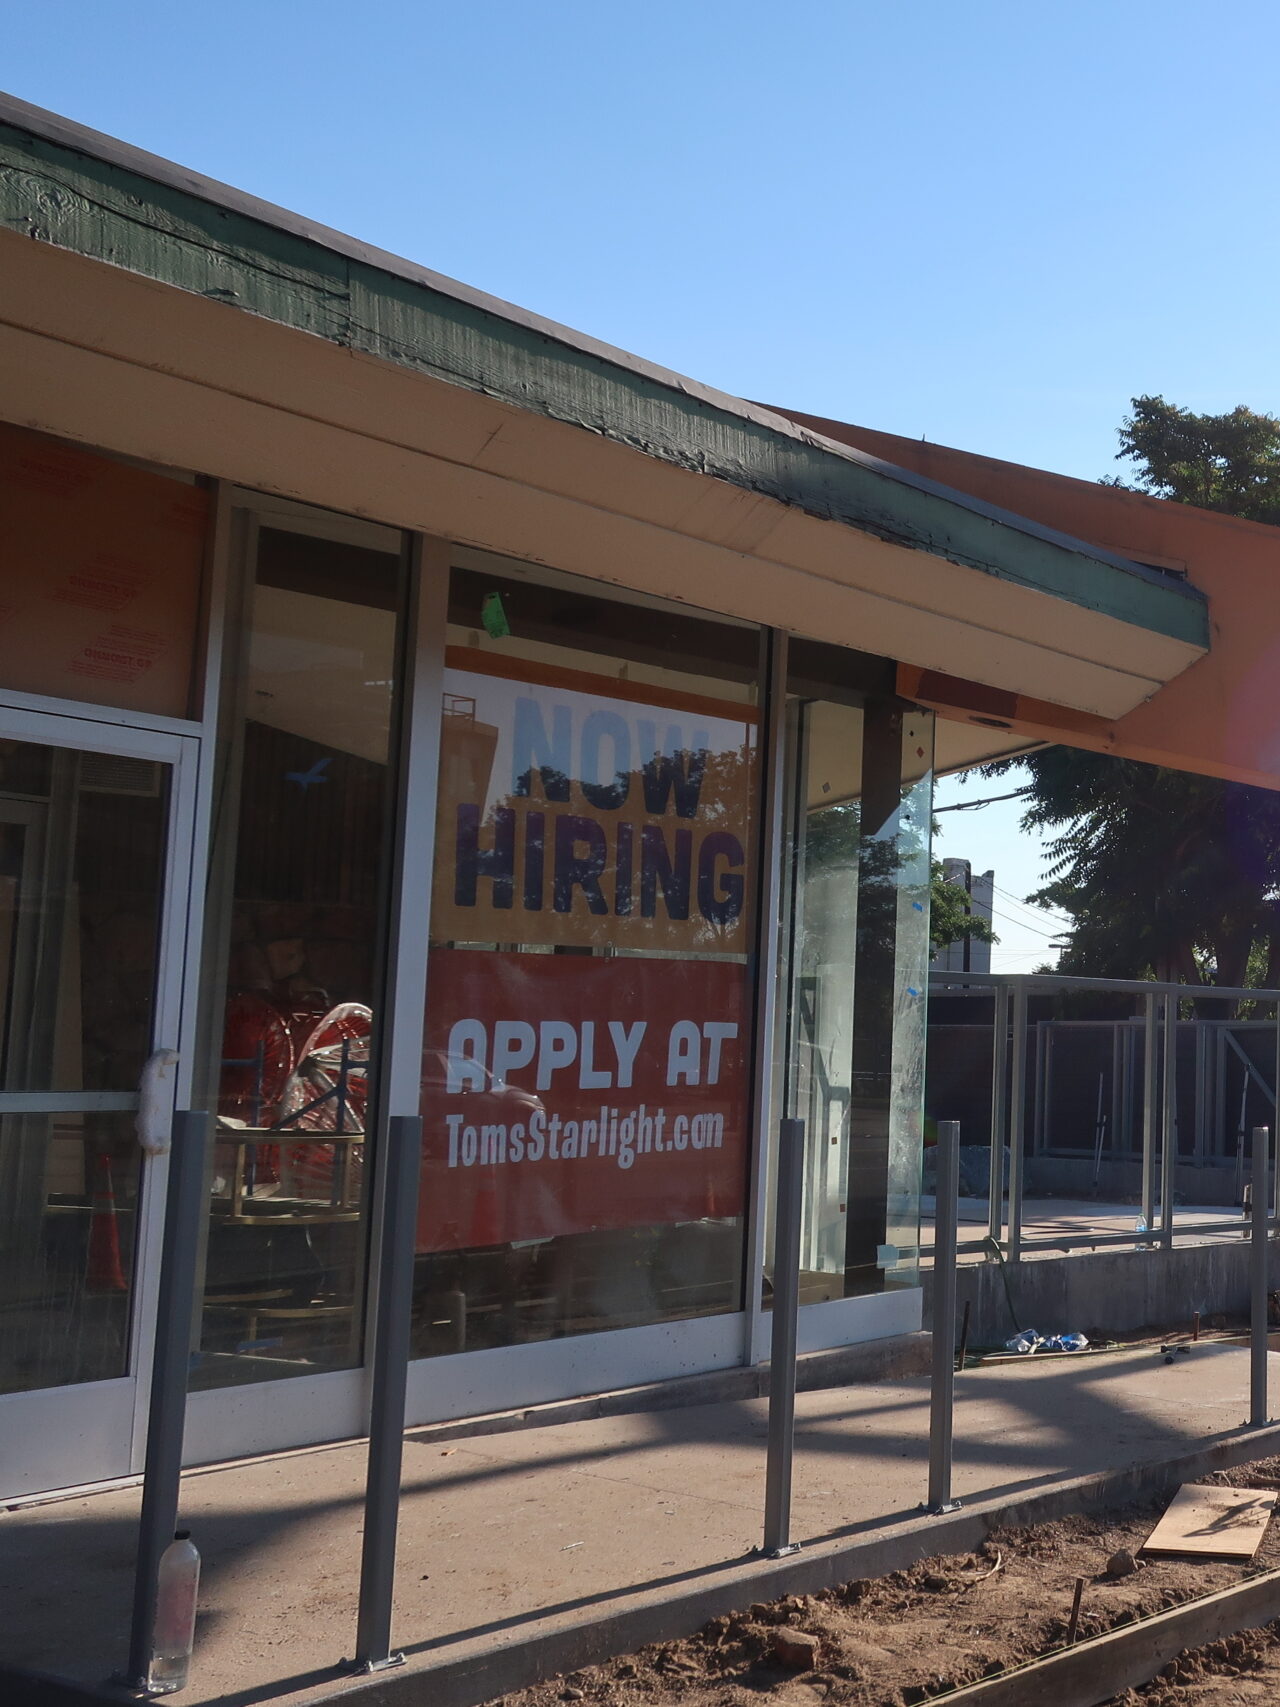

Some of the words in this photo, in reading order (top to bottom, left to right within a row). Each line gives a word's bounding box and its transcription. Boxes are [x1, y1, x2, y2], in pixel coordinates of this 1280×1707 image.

[512, 696, 709, 818] NOW
[454, 803, 745, 926] HIRING
[446, 1018, 647, 1094] APPLY
[666, 1019, 738, 1087] AT
[446, 1103, 724, 1169] TomsStarlight.com
